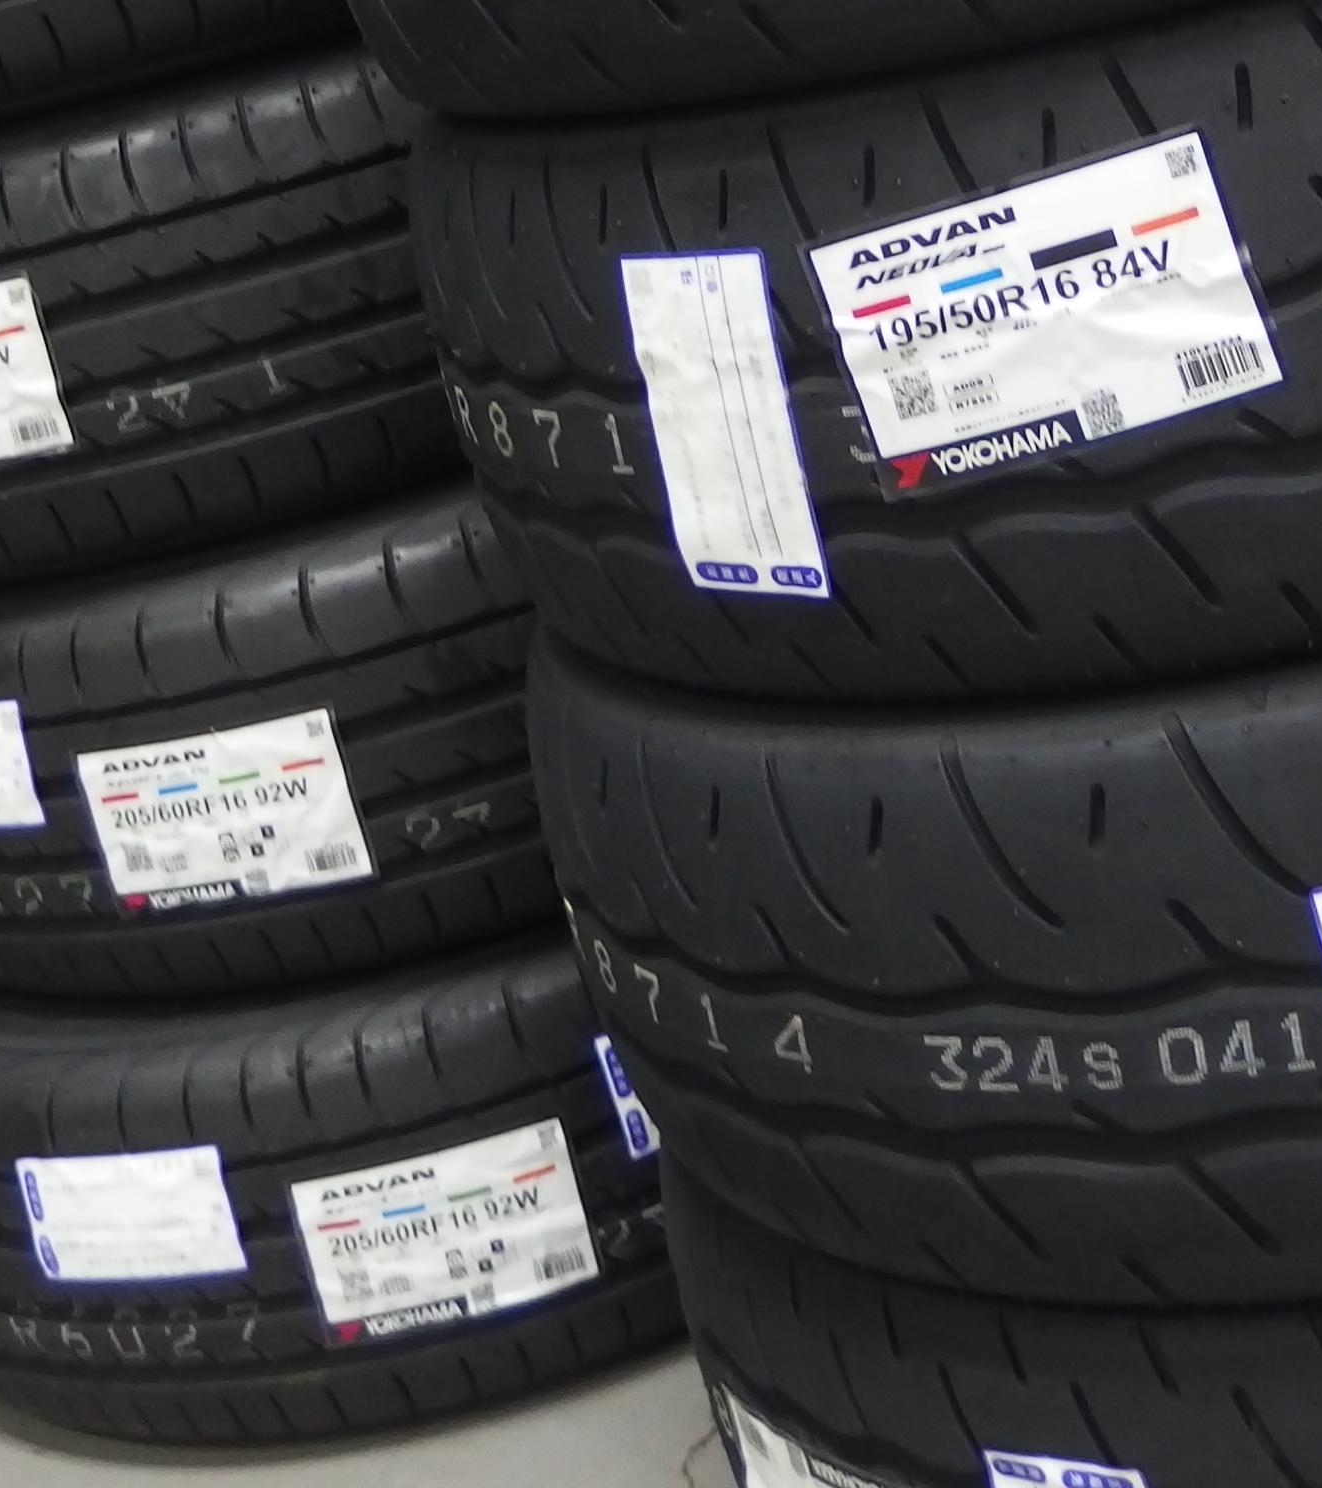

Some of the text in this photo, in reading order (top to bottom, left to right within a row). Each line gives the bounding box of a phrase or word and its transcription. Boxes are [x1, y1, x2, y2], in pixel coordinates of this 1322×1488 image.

[849, 206, 1015, 269] ADVAN
[869, 240, 1171, 352] 195/50R16 84V
[931, 421, 1071, 474] YOKOHAMA
[103, 749, 205, 774] ADVAN
[256, 779, 308, 805] 92W
[322, 1168, 435, 1201] ADVAN
[485, 1186, 539, 1220] 92W
[365, 1300, 462, 1335] YOKOHAMA
